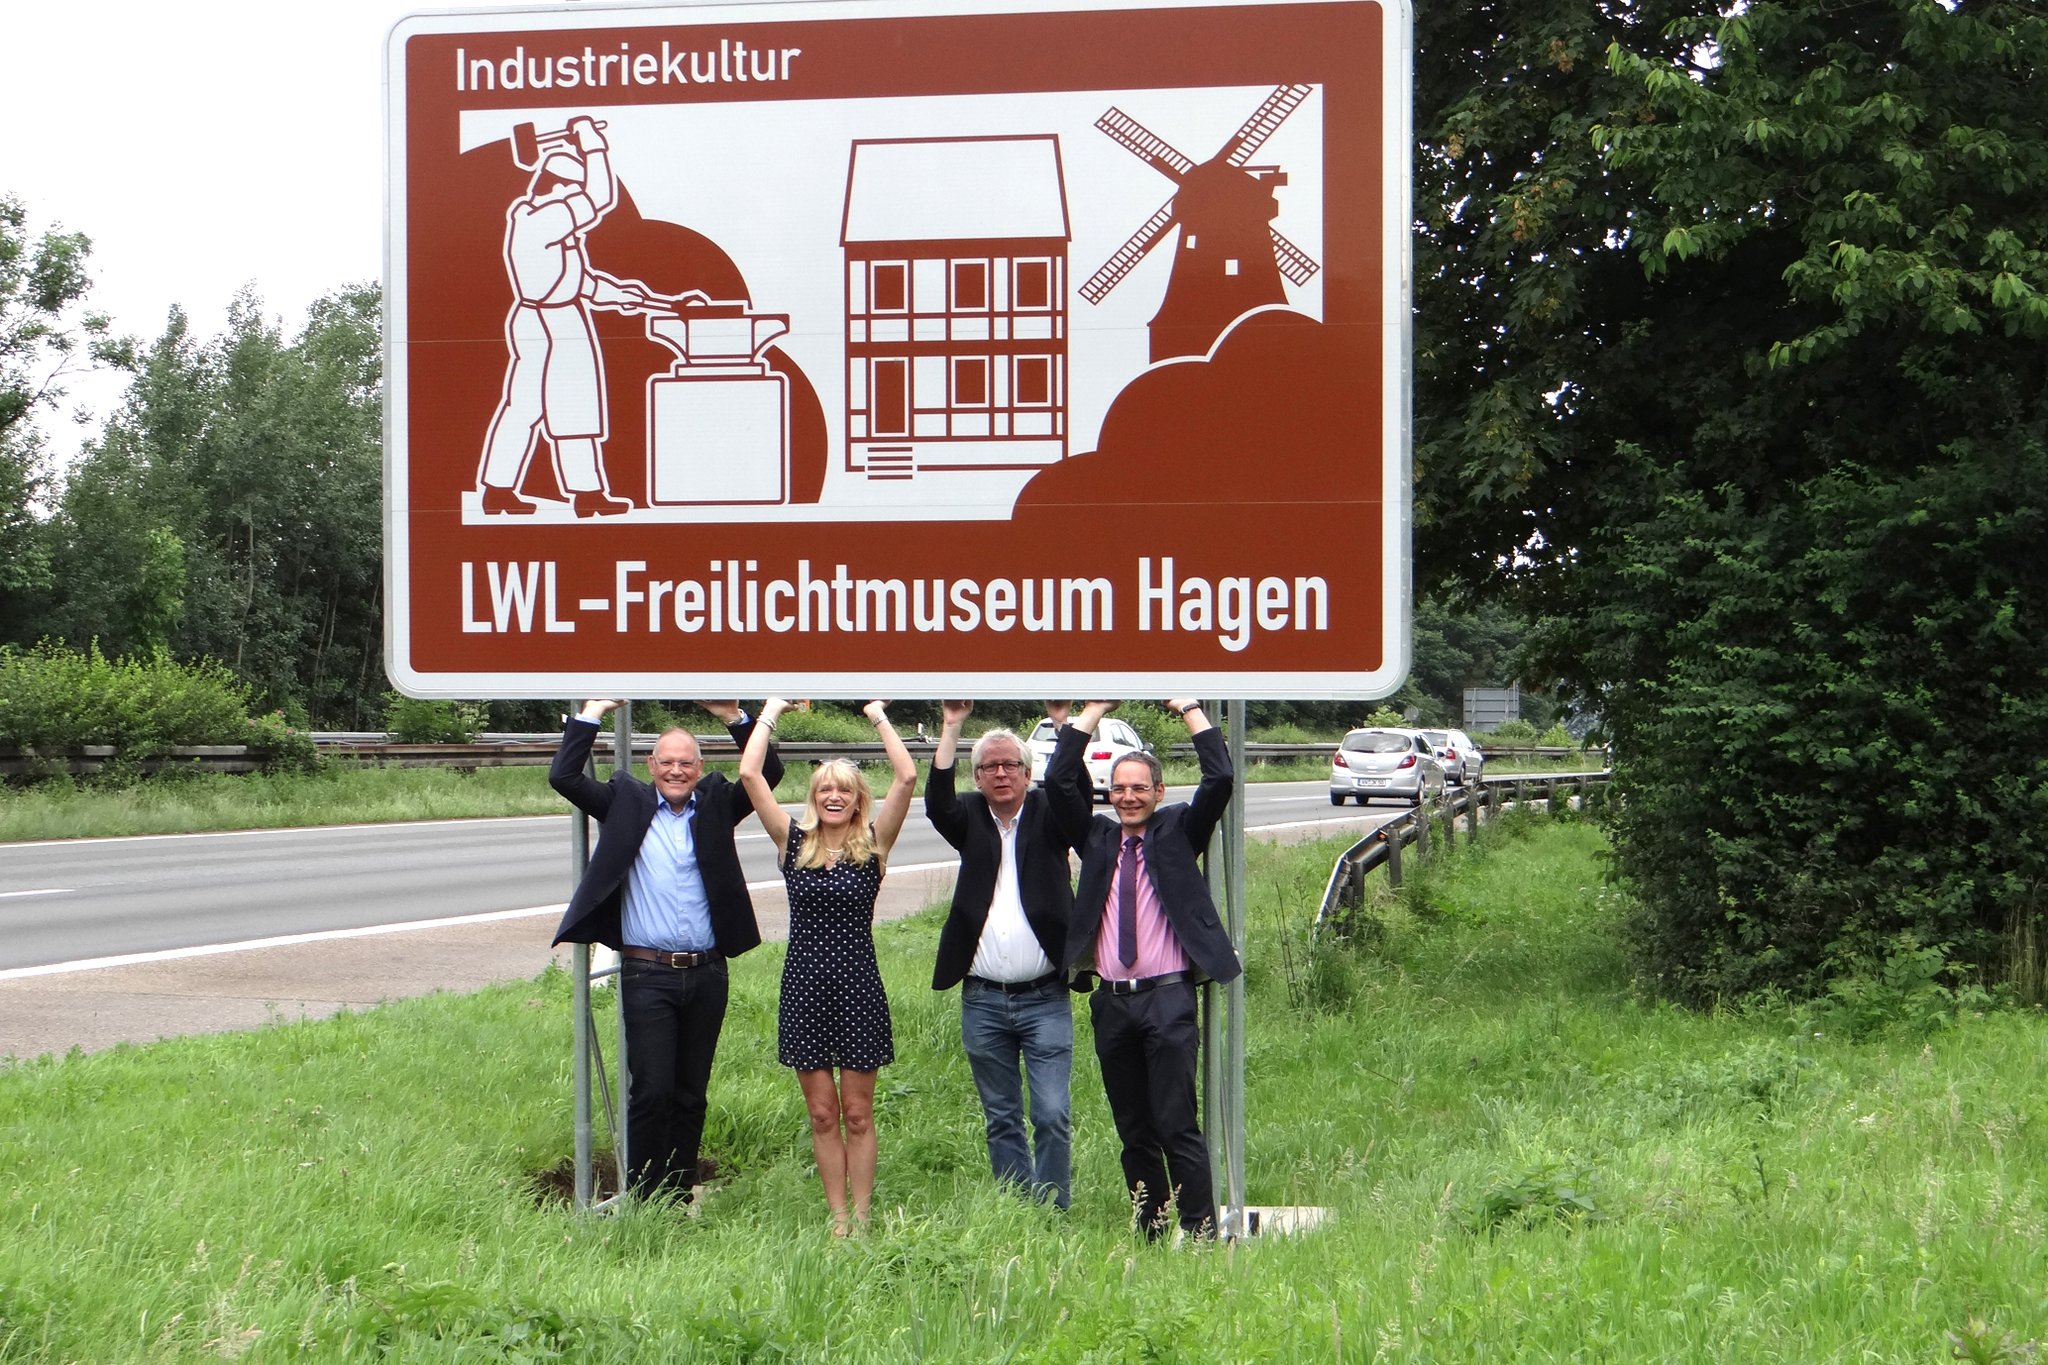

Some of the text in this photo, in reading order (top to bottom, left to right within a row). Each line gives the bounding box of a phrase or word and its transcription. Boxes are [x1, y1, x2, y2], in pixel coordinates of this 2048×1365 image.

[456, 39, 802, 91] Industriekultur
[461, 556, 1329, 652] LWL-Freilichtmuseum Hagen
